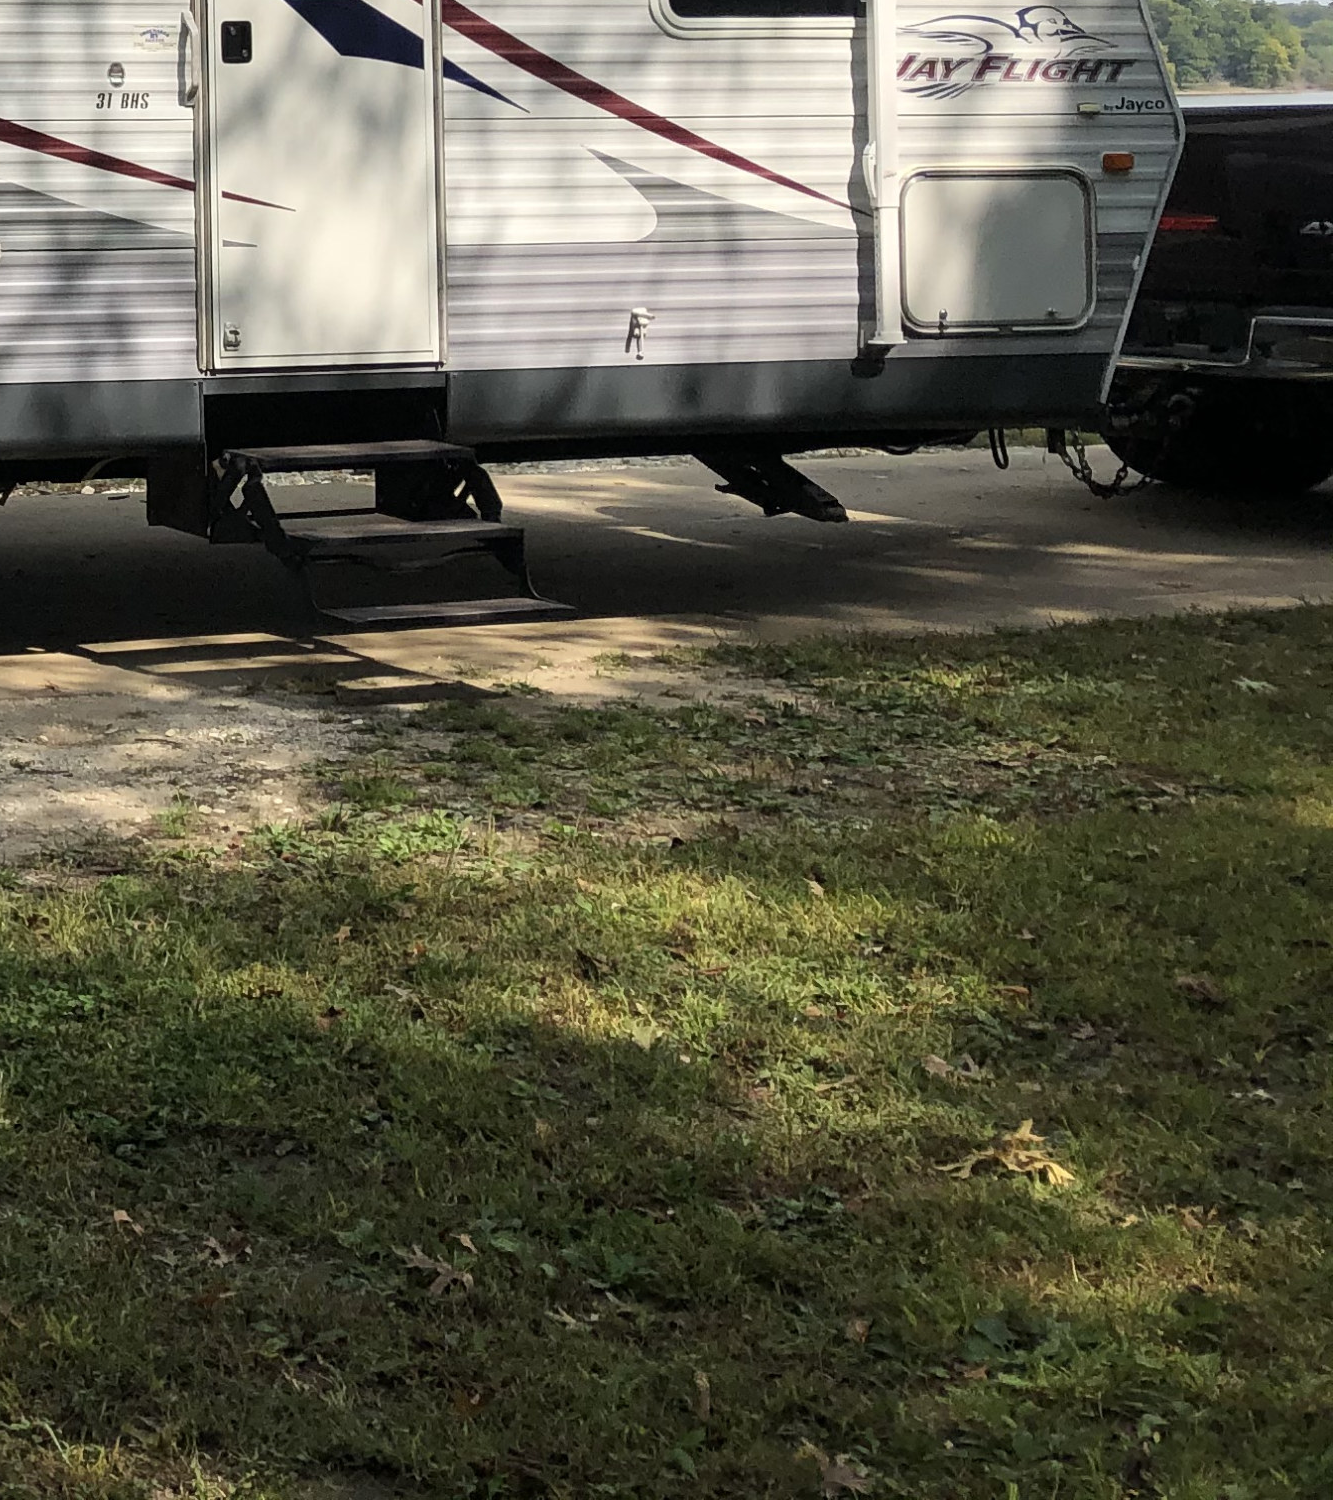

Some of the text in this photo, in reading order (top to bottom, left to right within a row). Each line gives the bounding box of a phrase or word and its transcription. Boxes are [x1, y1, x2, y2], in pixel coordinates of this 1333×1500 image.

[896, 52, 1138, 83] JAY FLIGHT
[96, 92, 150, 109] 31 BHS
[1115, 96, 1165, 113] Jayco
